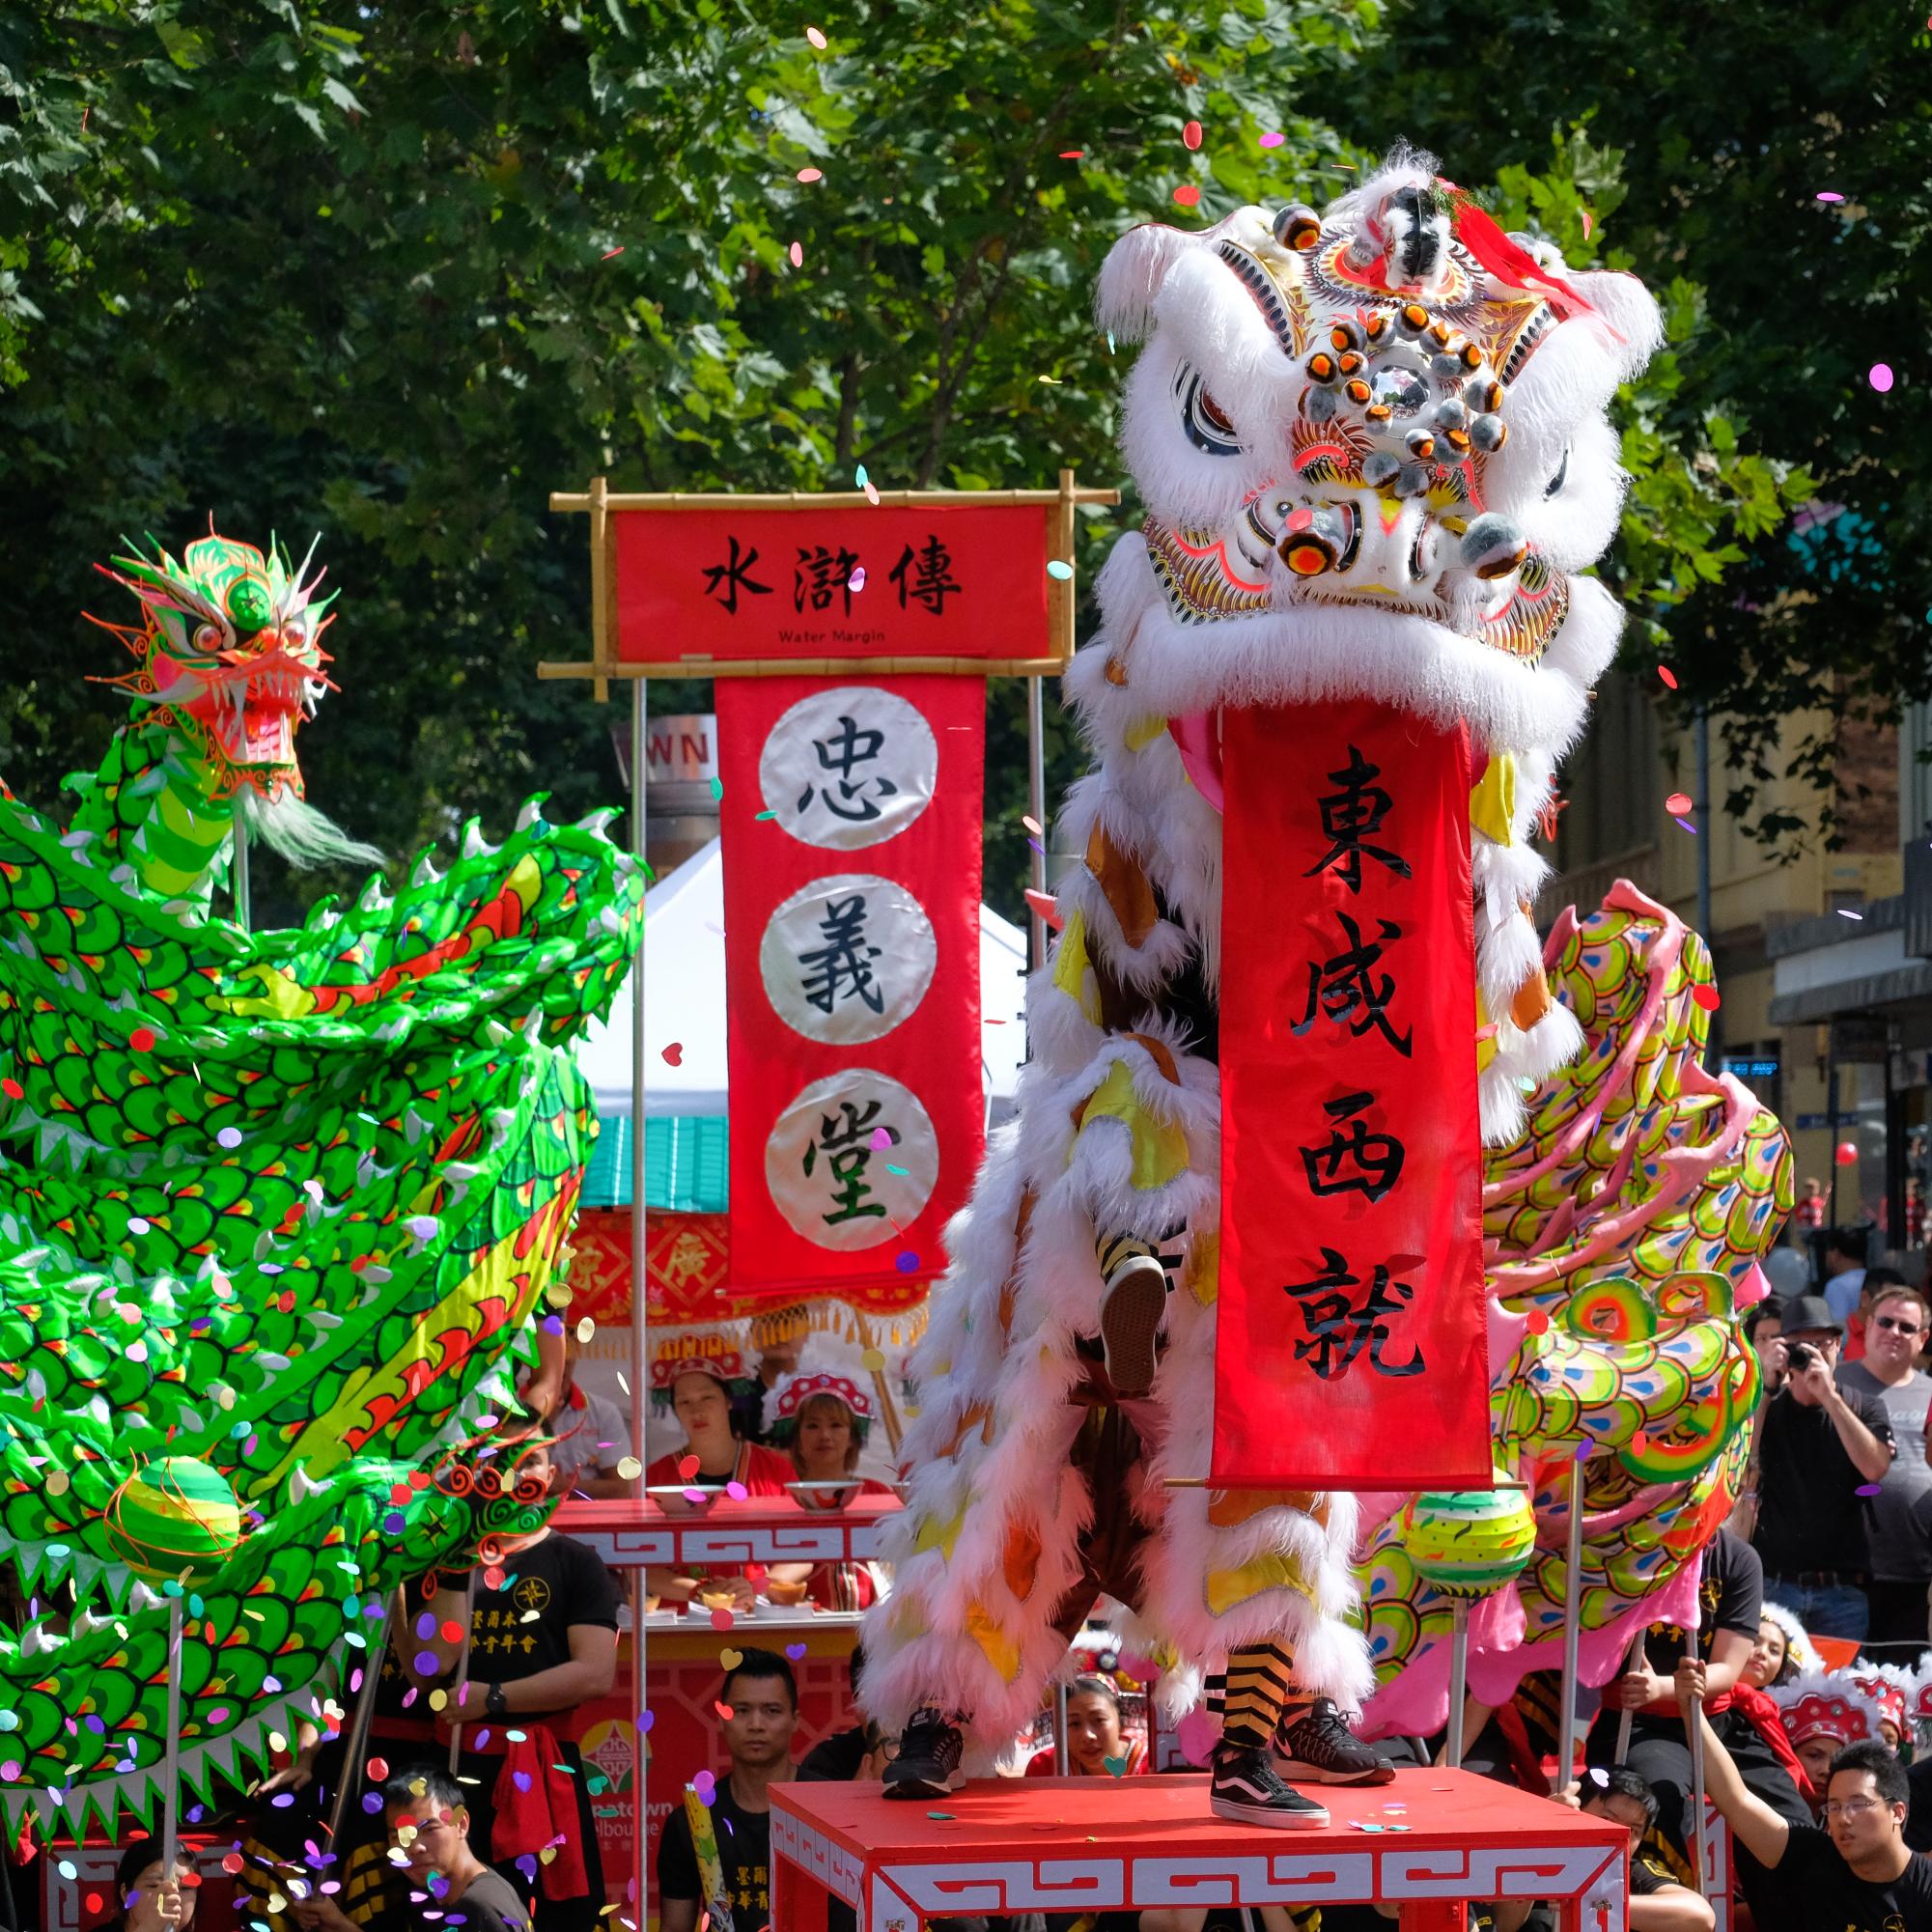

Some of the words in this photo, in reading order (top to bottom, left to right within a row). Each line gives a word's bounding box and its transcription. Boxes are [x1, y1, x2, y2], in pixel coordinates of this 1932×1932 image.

[702, 535, 963, 619] 水滸傳
[778, 630, 826, 644] Water
[832, 630, 886, 645] Margin
[798, 715, 903, 1226] 忠義堂
